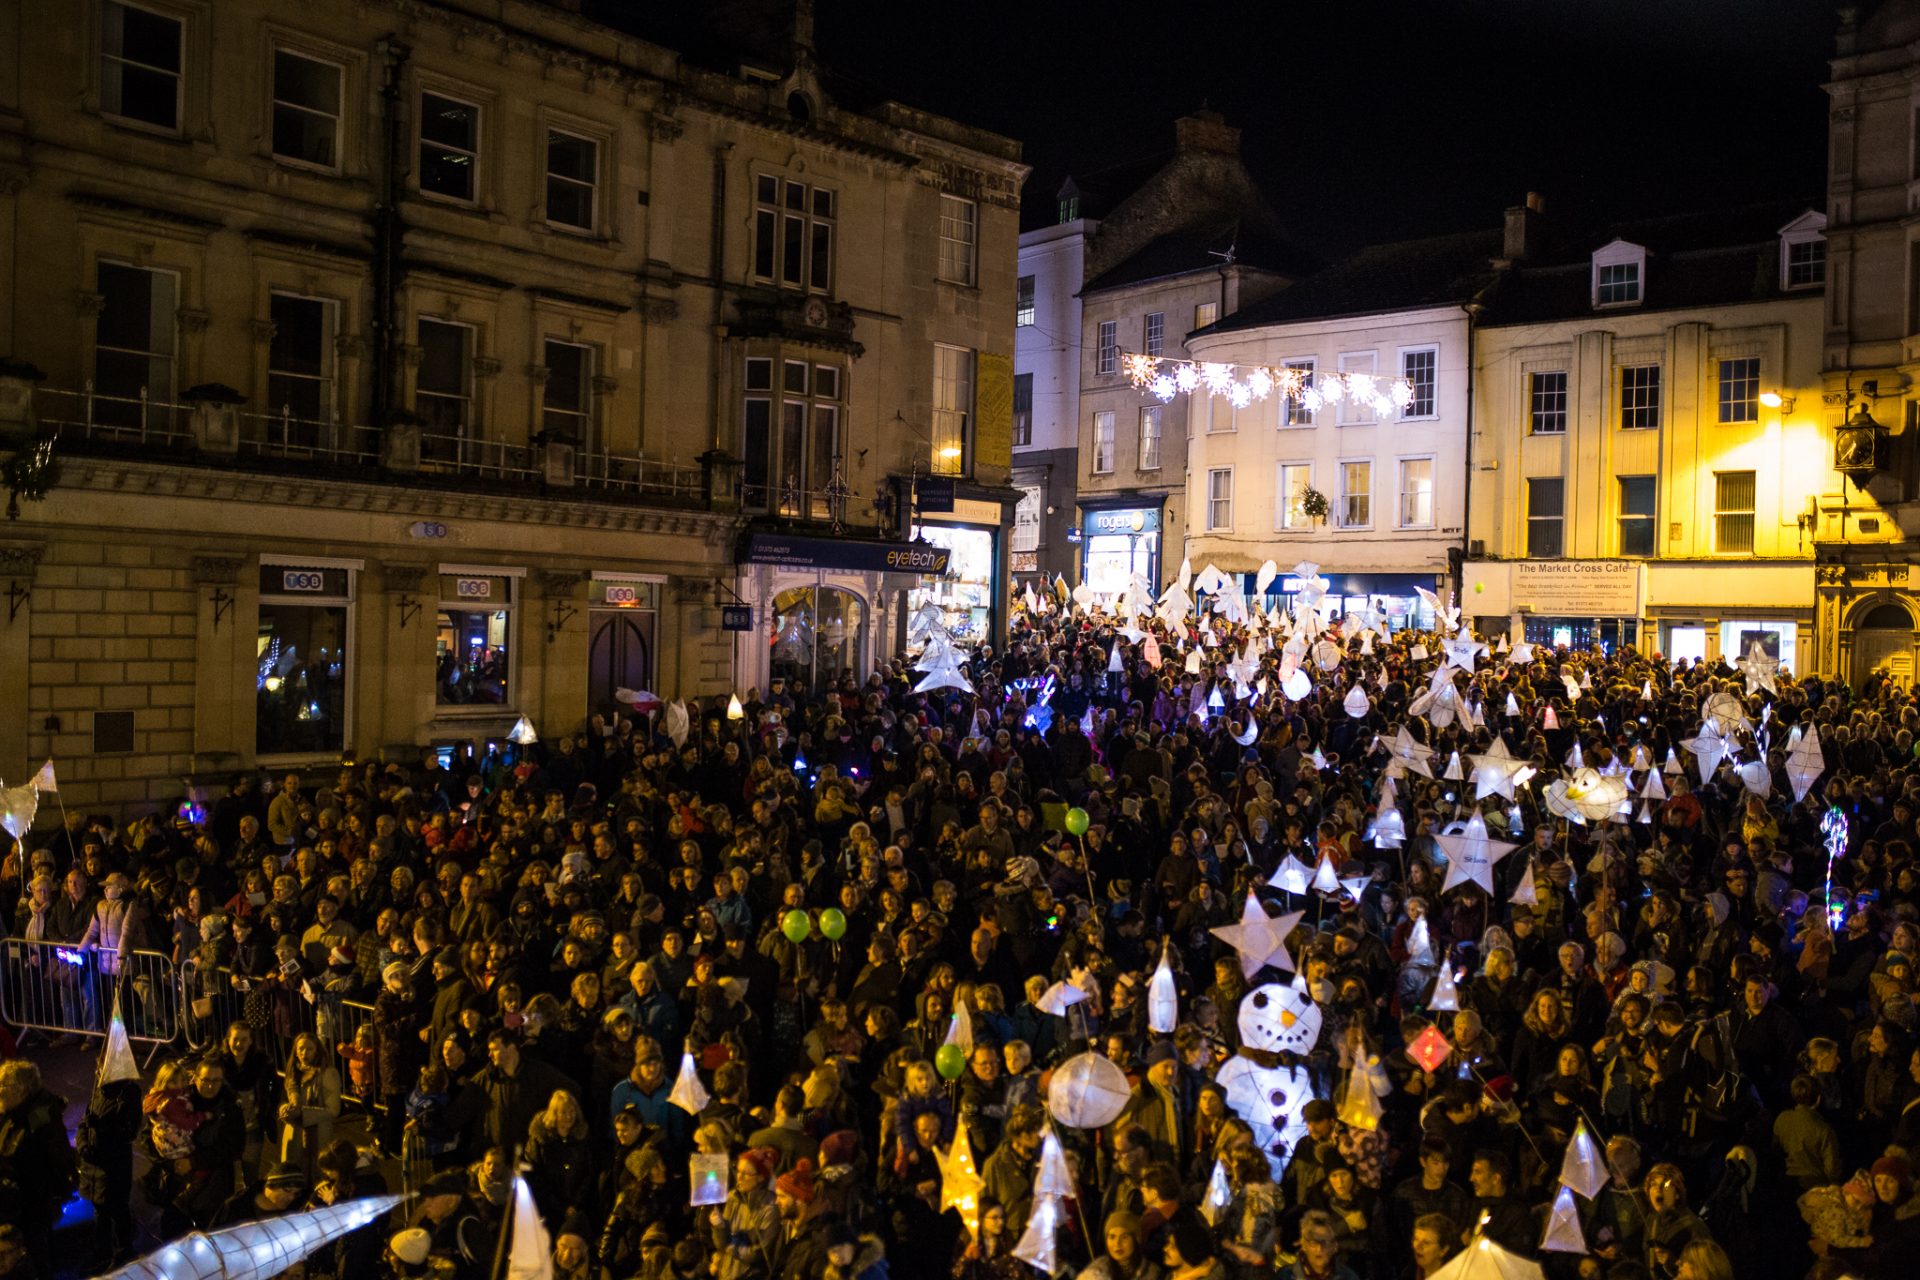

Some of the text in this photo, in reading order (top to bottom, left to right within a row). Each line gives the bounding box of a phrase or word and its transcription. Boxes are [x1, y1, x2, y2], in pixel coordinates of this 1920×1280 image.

[1098, 515, 1131, 532] rogers
[888, 549, 934, 567] eyetech
[1518, 564, 1536, 573] The
[1539, 563, 1571, 573] Market
[1574, 563, 1602, 573] Cross
[287, 574, 320, 588] TSB
[460, 582, 488, 594] TSB
